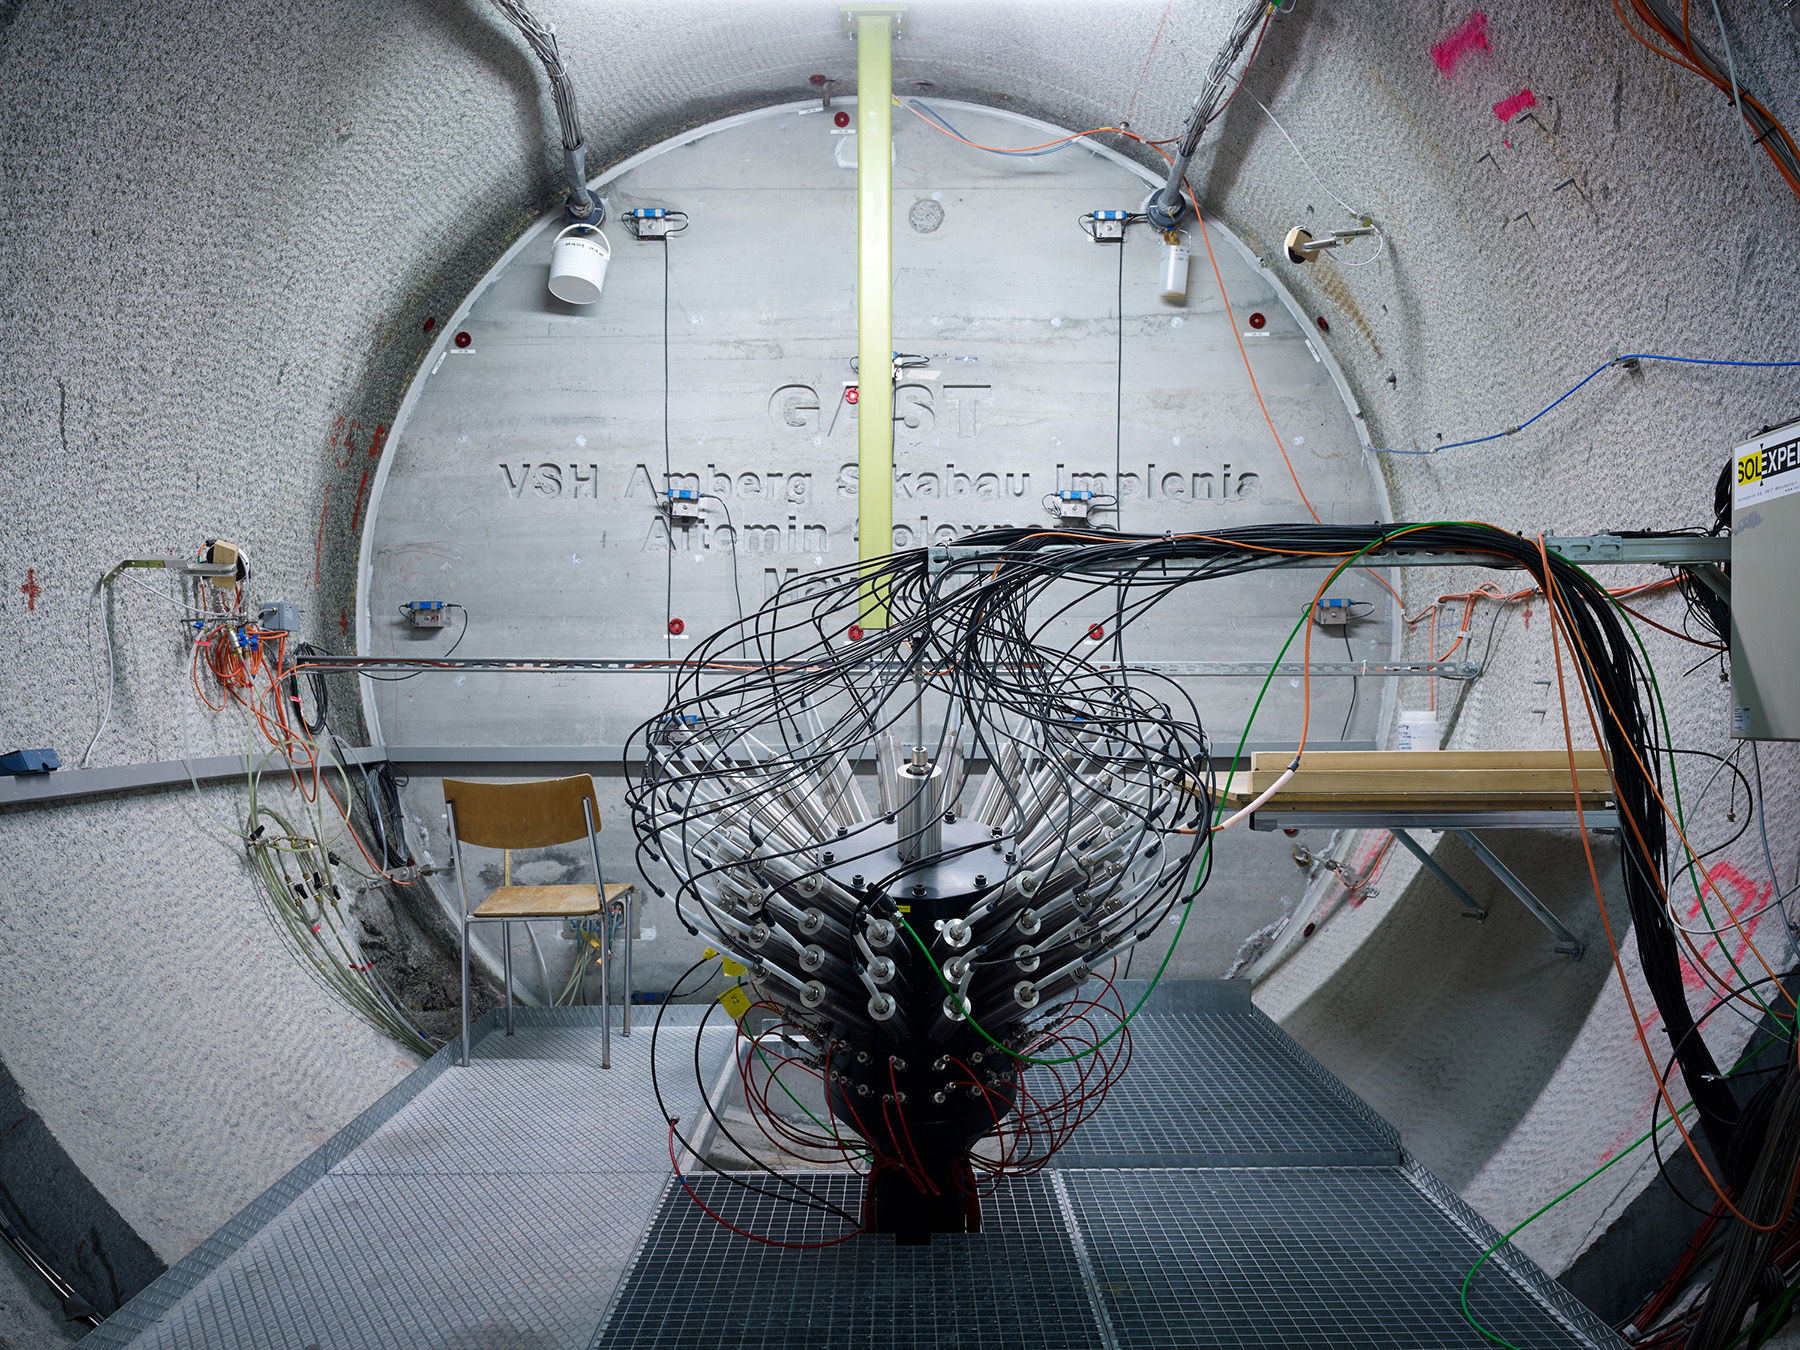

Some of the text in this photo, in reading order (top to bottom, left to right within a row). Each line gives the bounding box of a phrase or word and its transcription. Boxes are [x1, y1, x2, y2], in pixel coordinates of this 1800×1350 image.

[1738, 441, 1800, 484] SOLEXPE
[499, 463, 598, 499] VSH
[624, 463, 812, 505] Amberg
[1056, 463, 1263, 506] Implenia
